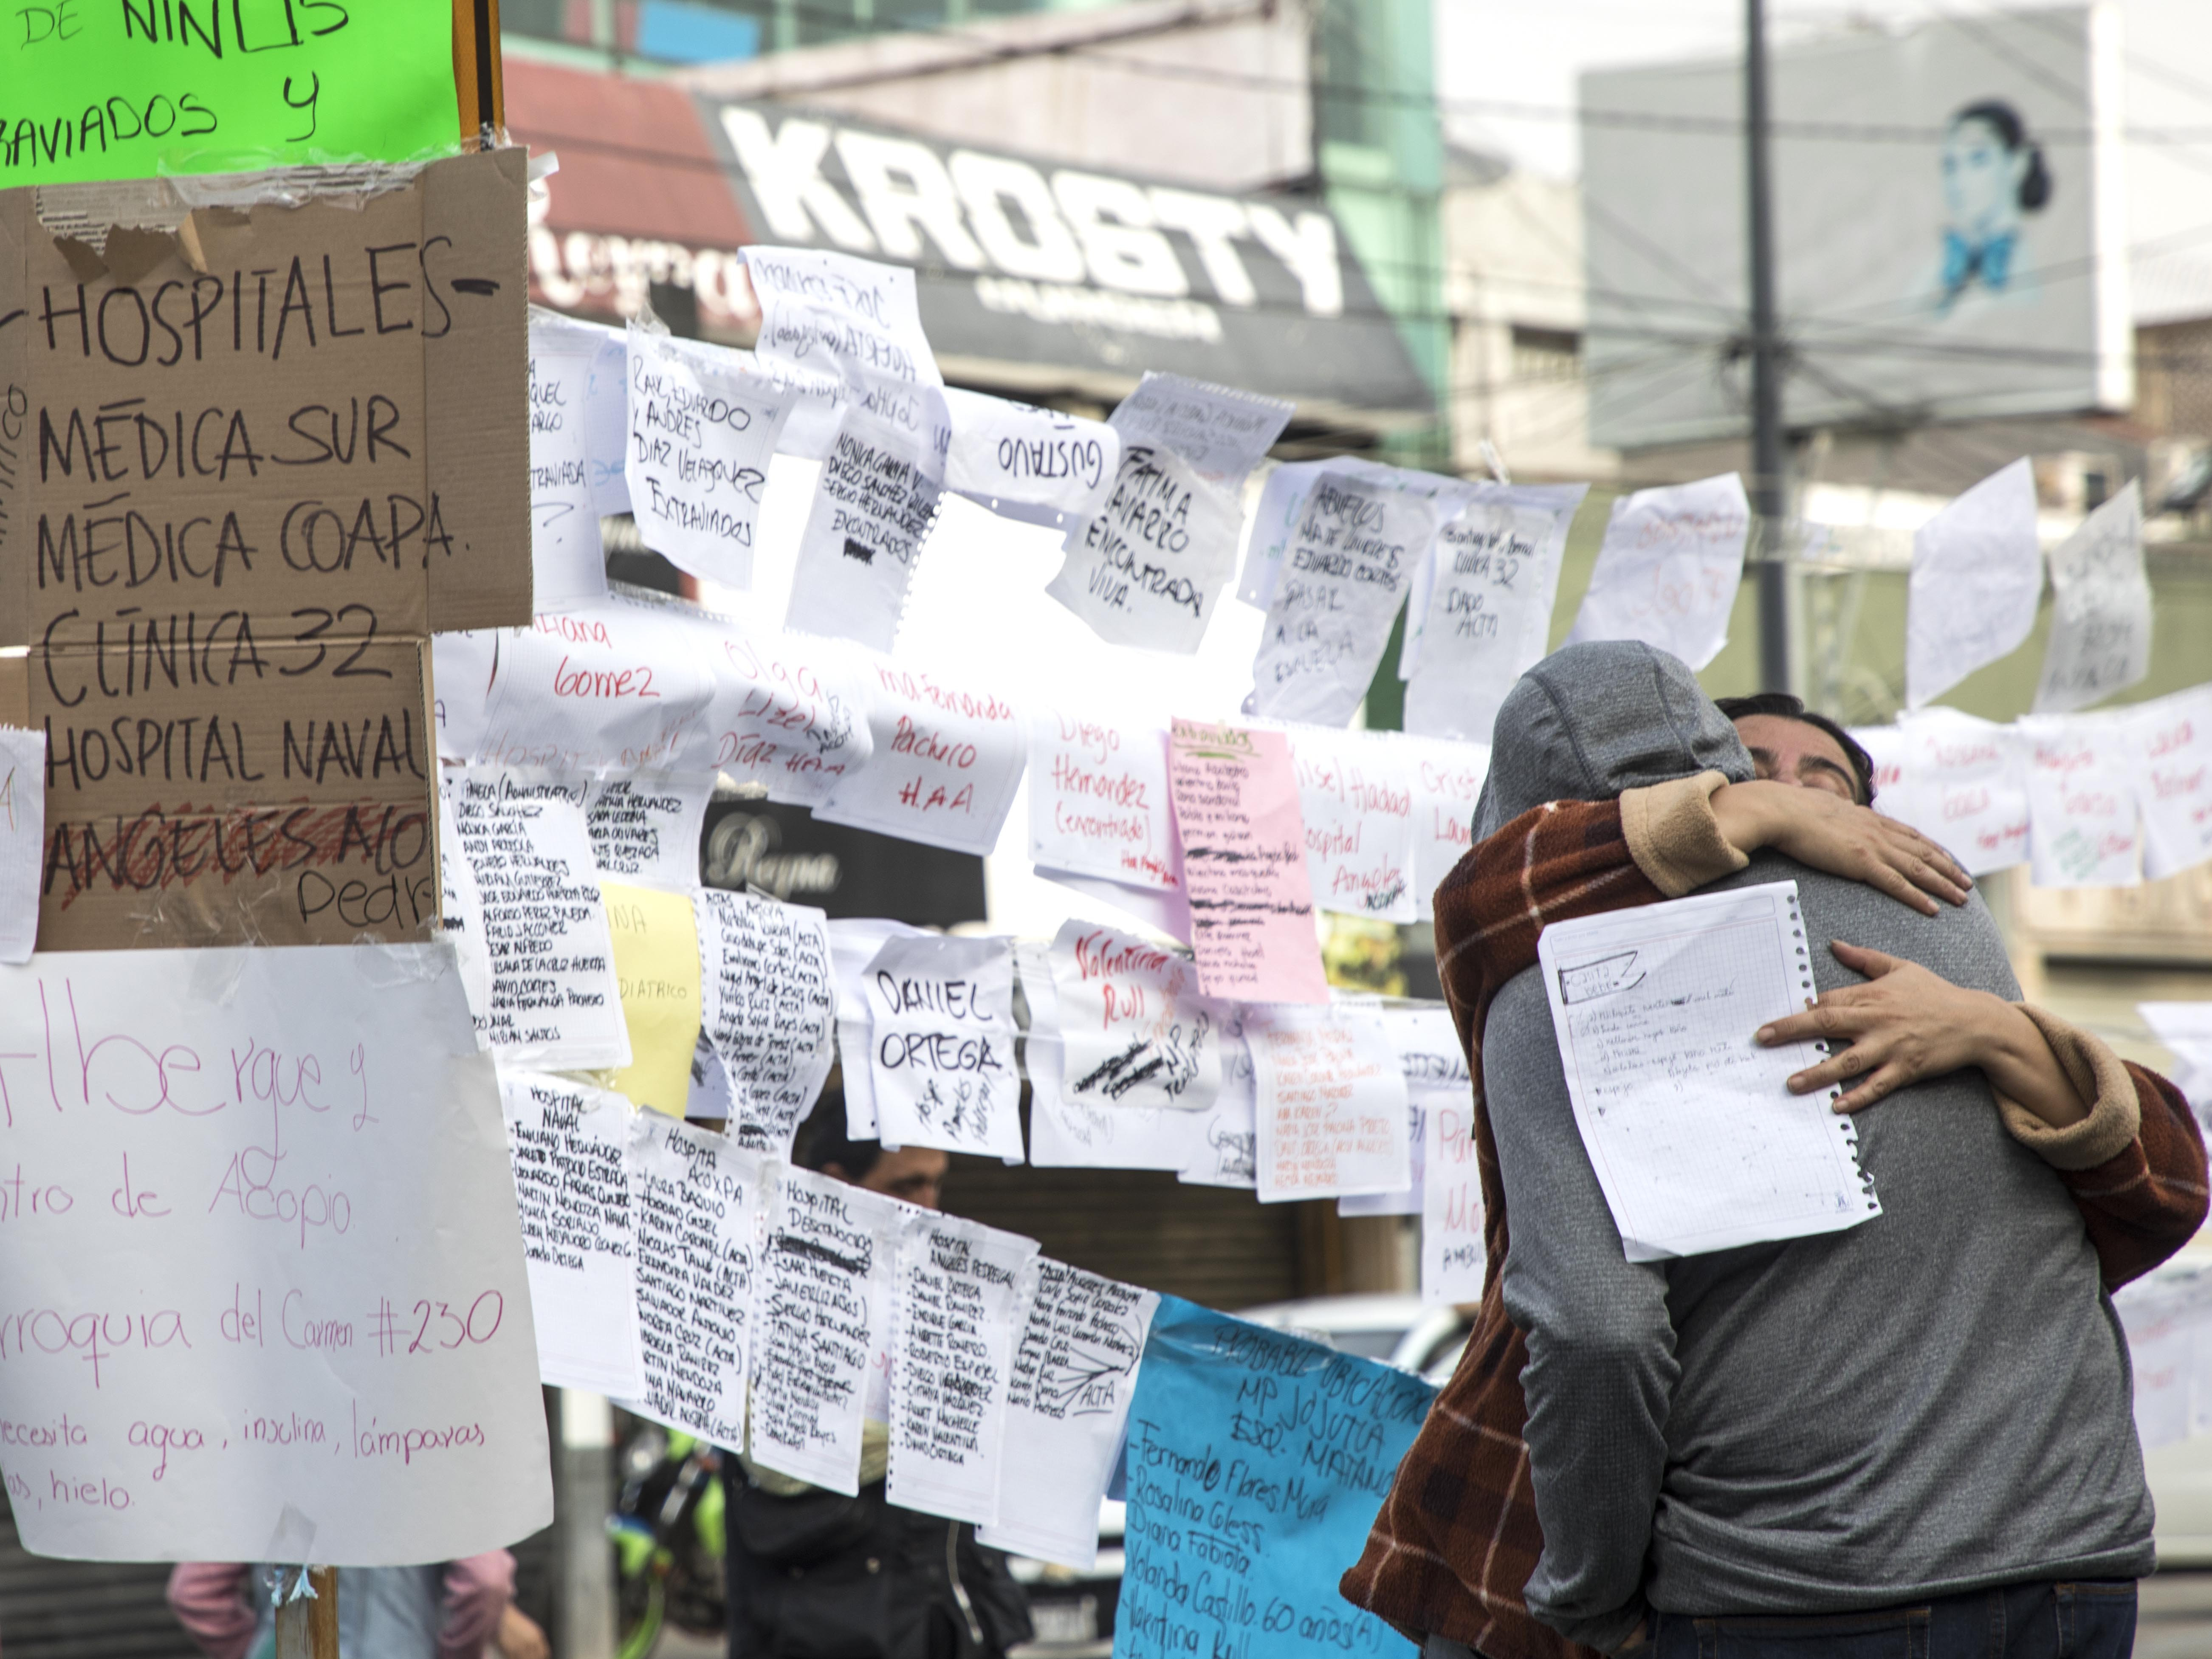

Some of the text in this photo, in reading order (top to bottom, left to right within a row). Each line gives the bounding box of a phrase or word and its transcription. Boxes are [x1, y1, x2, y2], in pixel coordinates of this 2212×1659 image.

[15, 7, 84, 50] DE
[718, 104, 1346, 318] KROSTY
[271, 394, 411, 465] SUR
[998, 437, 1103, 490] GUSTAVO
[278, 603, 392, 678] 32
[45, 708, 426, 790] HOSPITAL NAVAL
[876, 968, 993, 1022] DANIEL
[880, 1031, 1003, 1073] ORTEGA
[112, 1150, 172, 1218] de
[687, 1165, 743, 1206] ACOXPA
[220, 1282, 263, 1348] del
[281, 1289, 353, 1350] Carmen
[366, 1289, 503, 1358] #230
[1261, 1596, 1295, 1633] 60
